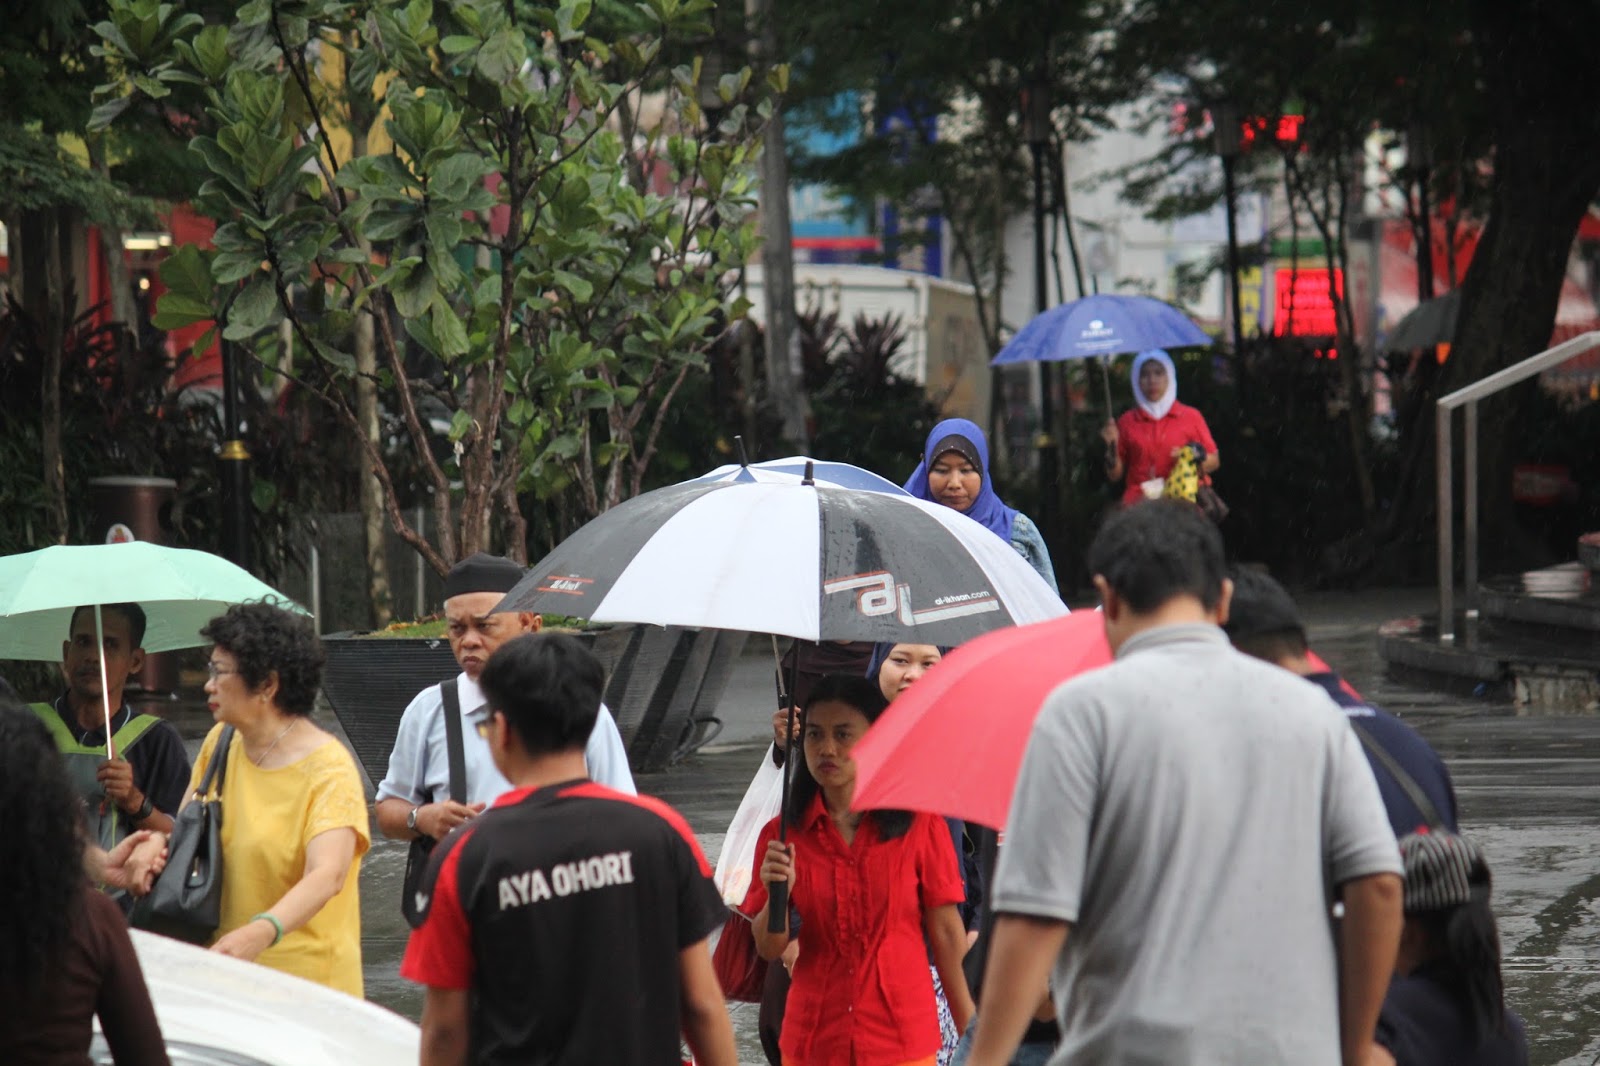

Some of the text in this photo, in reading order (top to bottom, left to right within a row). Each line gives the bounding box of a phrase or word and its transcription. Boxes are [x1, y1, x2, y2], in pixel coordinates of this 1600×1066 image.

[934, 590, 990, 605] al-ikhsan.com
[498, 850, 634, 911] AYA OHORI
